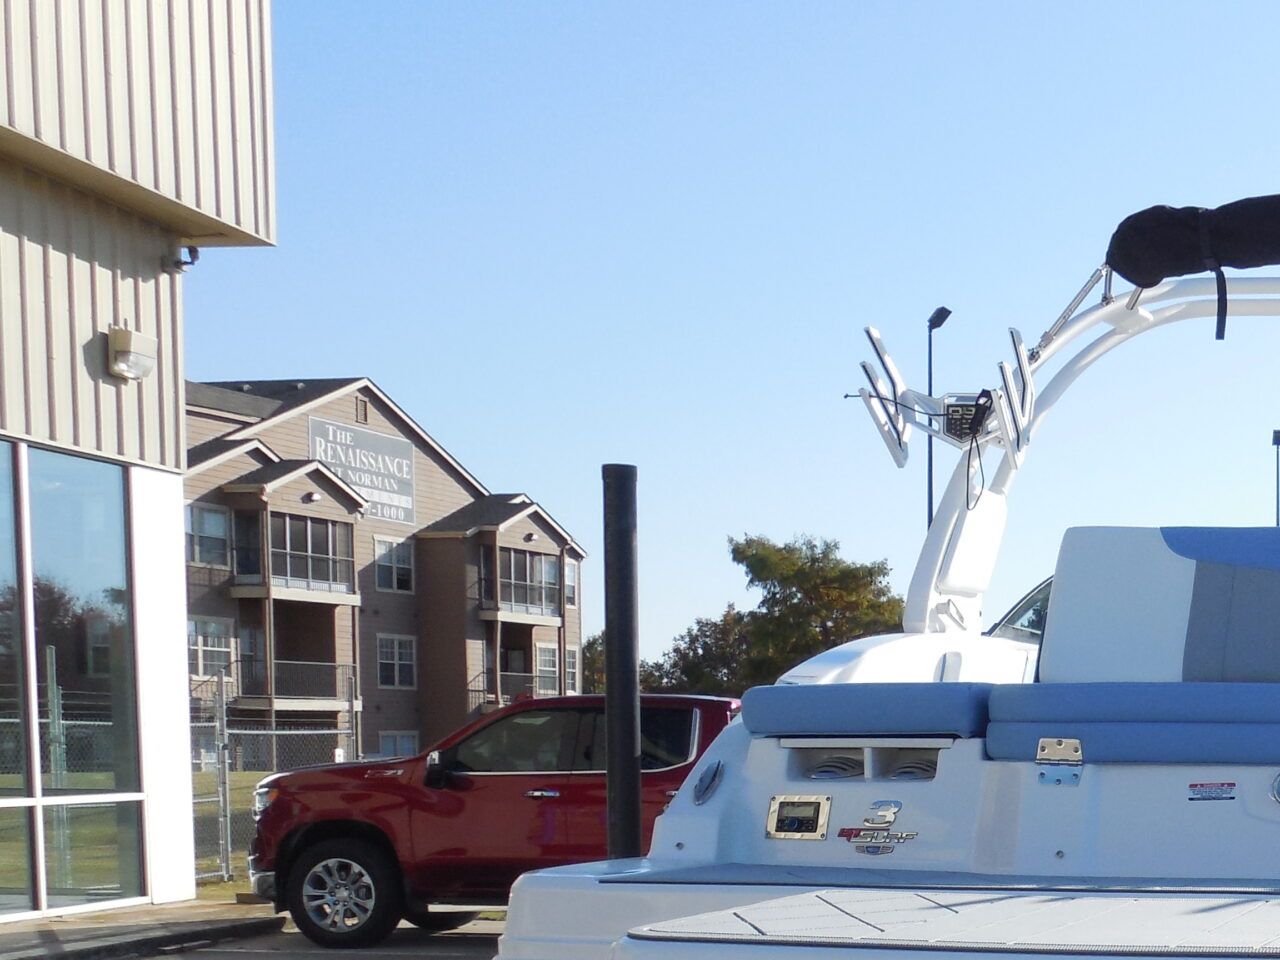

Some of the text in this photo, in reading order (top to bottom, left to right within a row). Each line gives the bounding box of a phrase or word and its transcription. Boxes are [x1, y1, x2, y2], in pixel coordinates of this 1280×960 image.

[325, 424, 354, 446] THE
[314, 436, 411, 479] RENAISSANCE
[347, 469, 399, 491] NORMAN
